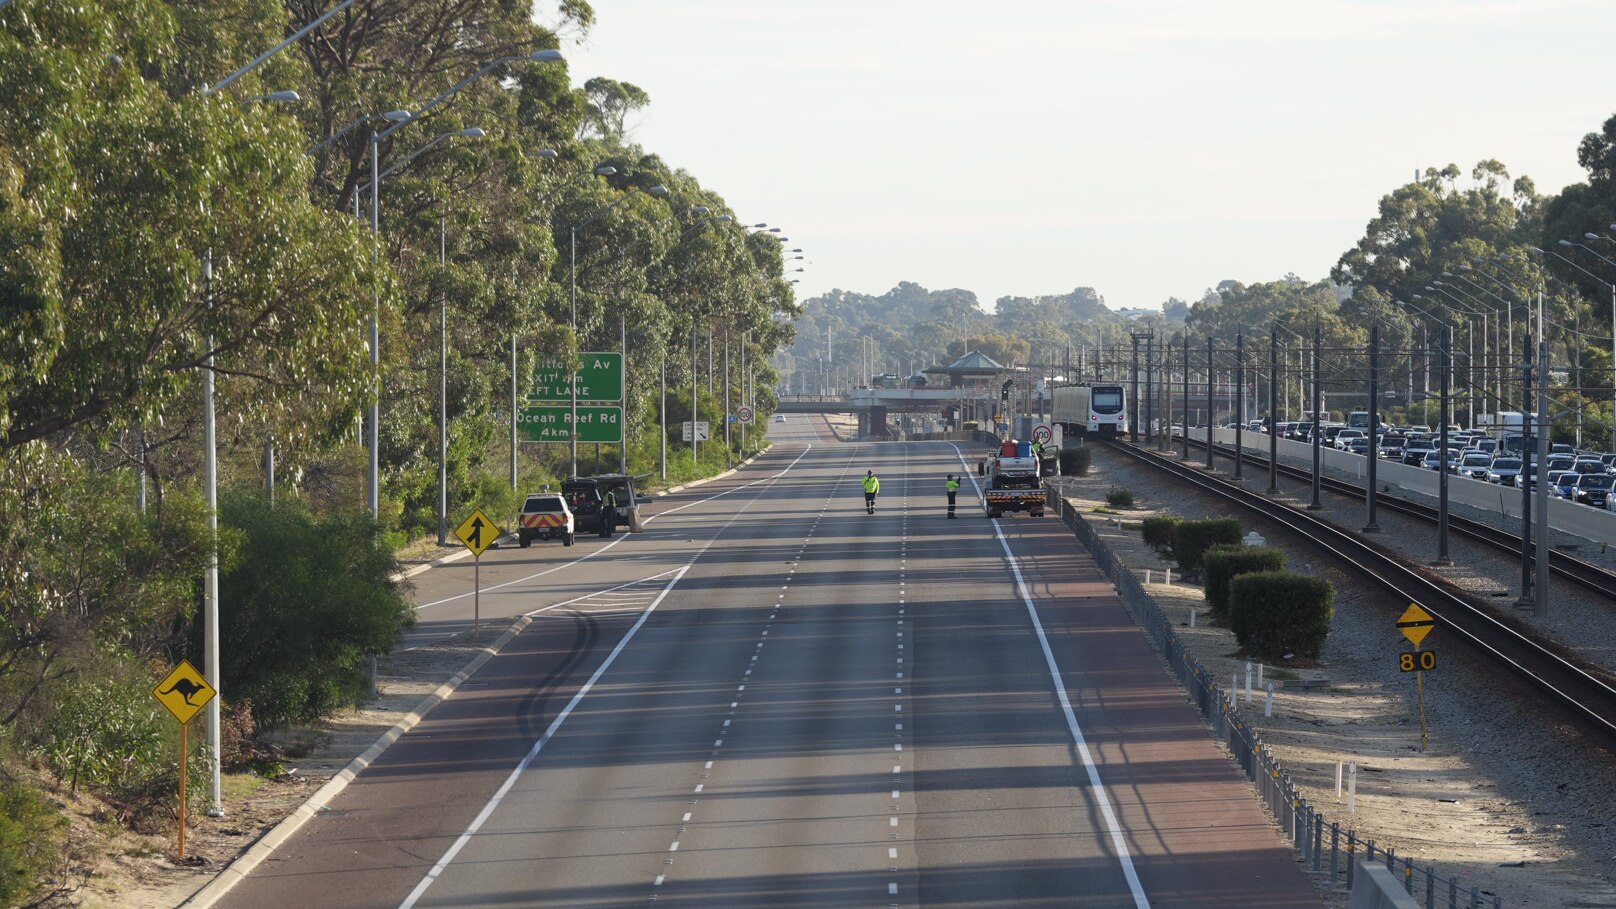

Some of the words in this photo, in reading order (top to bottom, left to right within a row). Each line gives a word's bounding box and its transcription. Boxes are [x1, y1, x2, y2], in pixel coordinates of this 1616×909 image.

[593, 359, 610, 369] Av
[535, 374, 555, 382] XIT
[528, 387, 549, 395] EFT
[556, 387, 589, 395] LANE
[517, 413, 555, 423] Ocean
[564, 413, 592, 423] Reef
[600, 413, 616, 423] Rd
[541, 428, 568, 436] 4km
[1401, 651, 1435, 671] 80
